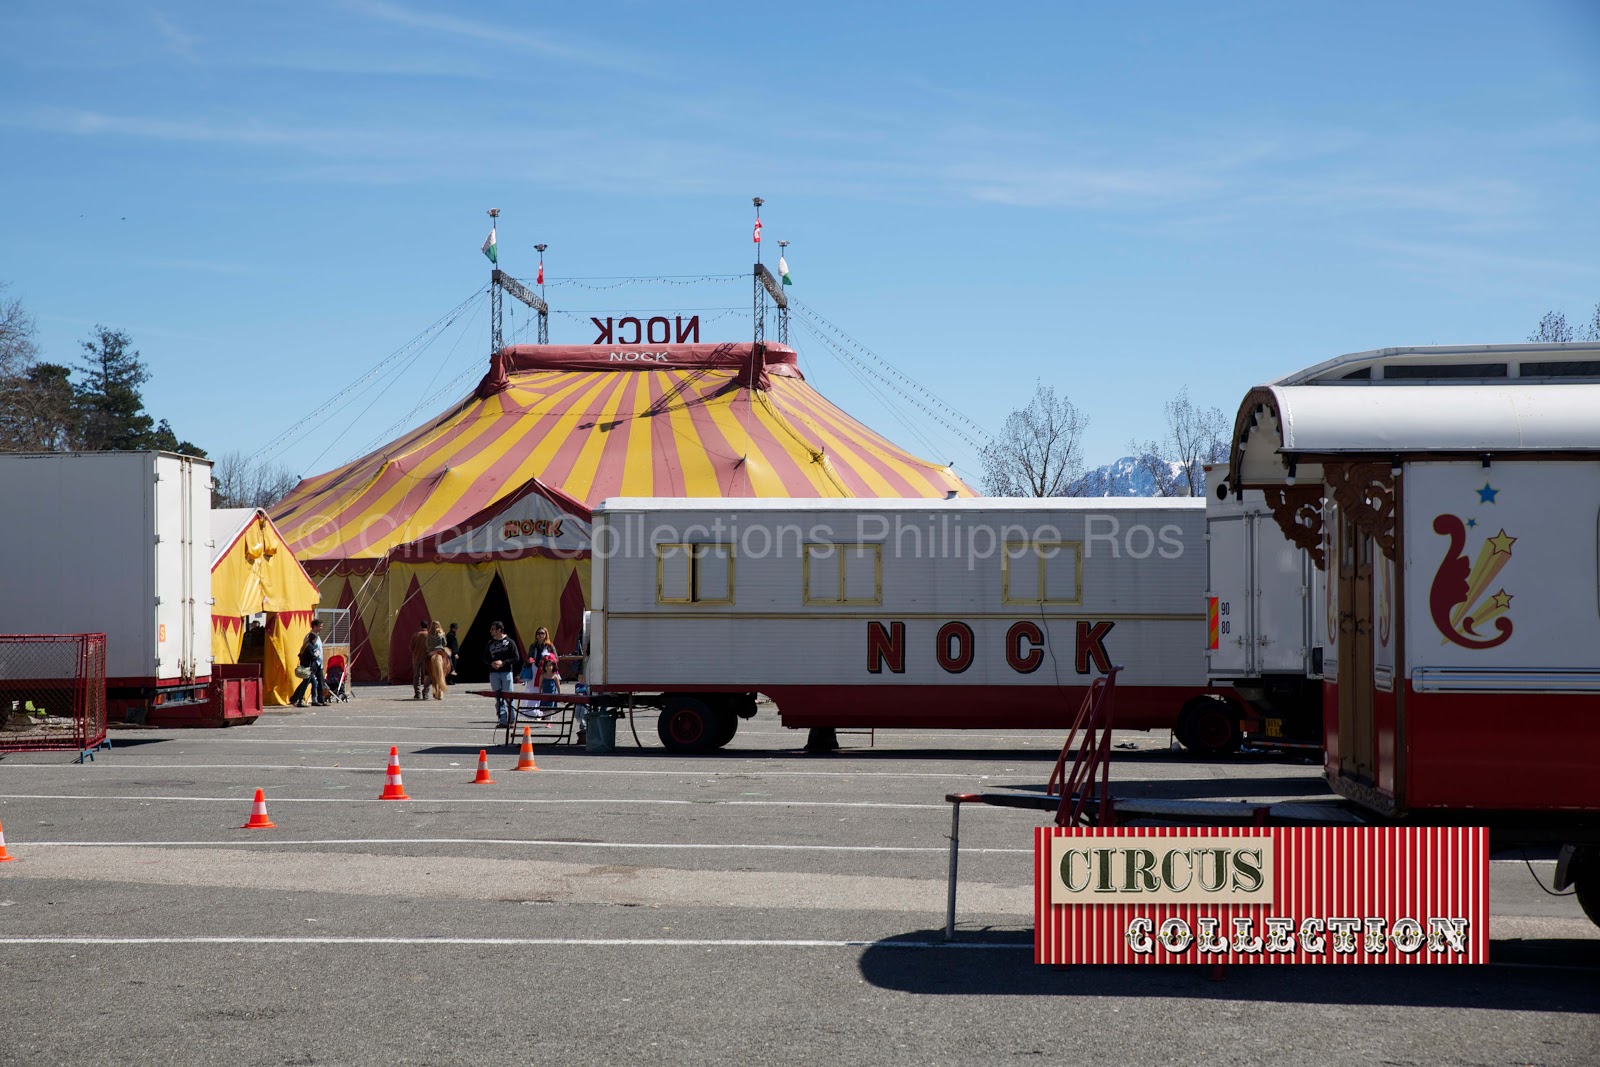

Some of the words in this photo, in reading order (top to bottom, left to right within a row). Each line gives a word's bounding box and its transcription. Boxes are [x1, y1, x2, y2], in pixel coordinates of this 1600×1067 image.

[609, 352, 668, 362] NOCK
[504, 519, 564, 541] NOCK
[1221, 602, 1230, 615] 90
[1221, 621, 1230, 634] 80
[867, 621, 1115, 674] NOCK
